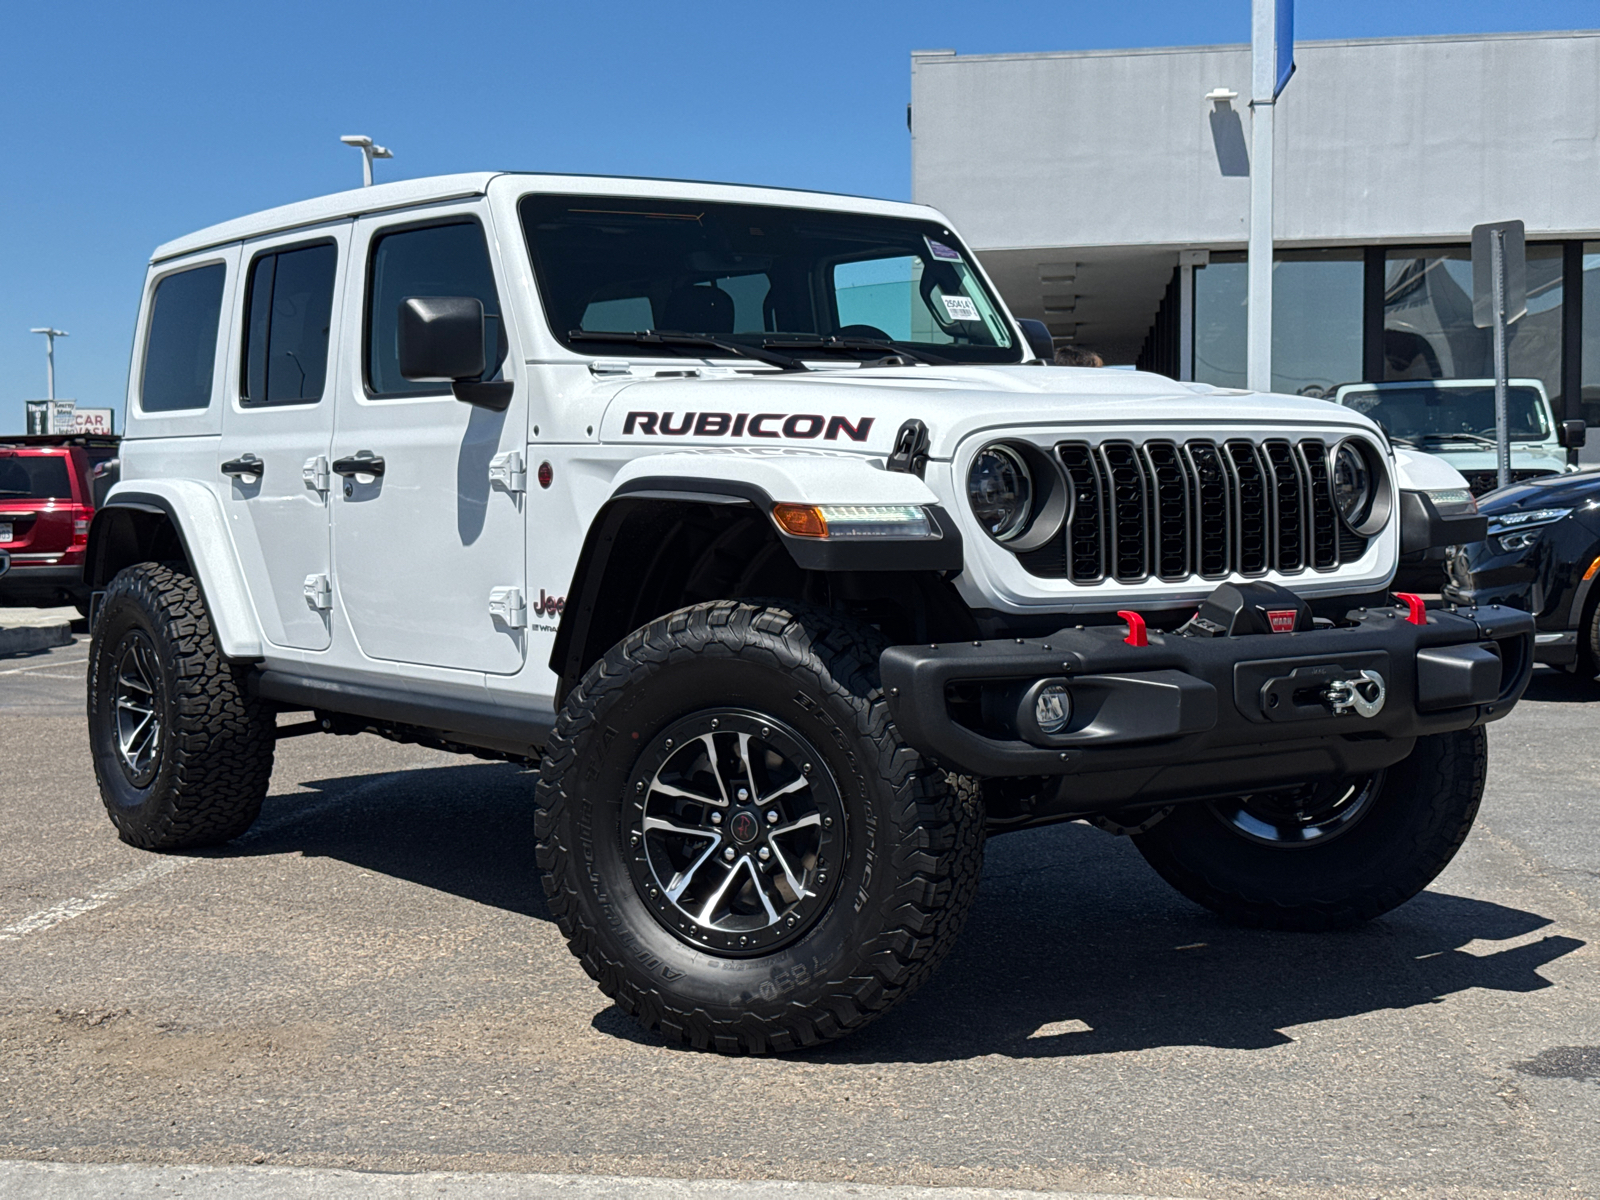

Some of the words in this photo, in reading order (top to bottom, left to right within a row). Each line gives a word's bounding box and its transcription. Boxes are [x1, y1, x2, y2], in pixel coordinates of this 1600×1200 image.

[75, 414, 104, 426] CAR
[622, 411, 876, 442] RUBICON
[533, 589, 566, 618] Jee
[793, 689, 879, 914] BFGoodrich
